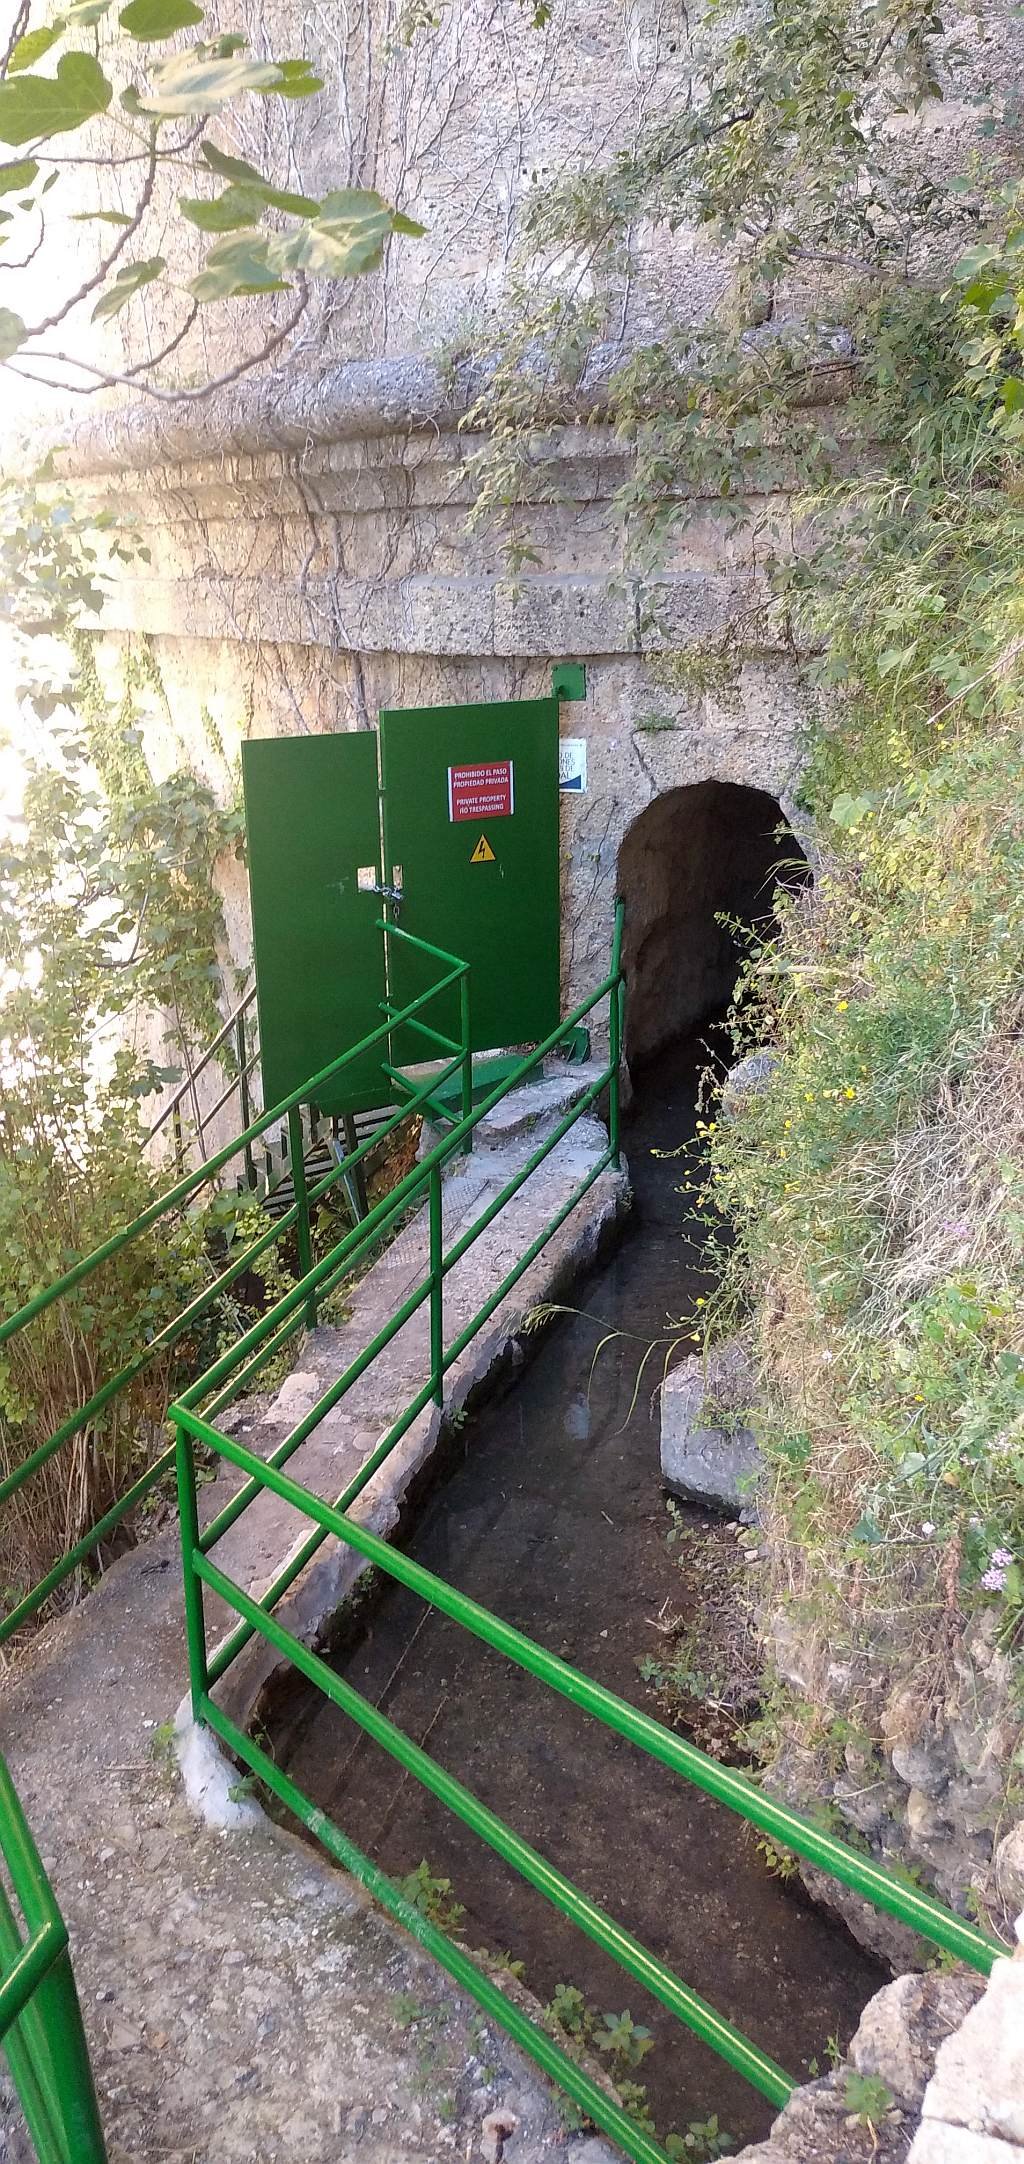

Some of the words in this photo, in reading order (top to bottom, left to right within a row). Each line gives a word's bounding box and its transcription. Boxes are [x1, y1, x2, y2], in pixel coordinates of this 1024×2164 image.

[454, 770, 486, 780] PROHIBIDO
[485, 769, 493, 777] EL
[492, 768, 507, 776] PASO
[453, 779, 485, 788] PROPIEDAD
[485, 777, 509, 785] PRIVADA
[456, 797, 478, 806] PRIVATE
[479, 794, 507, 804] PROPERTY
[459, 806, 469, 815] NO
[469, 803, 504, 813] TRESPASSING
